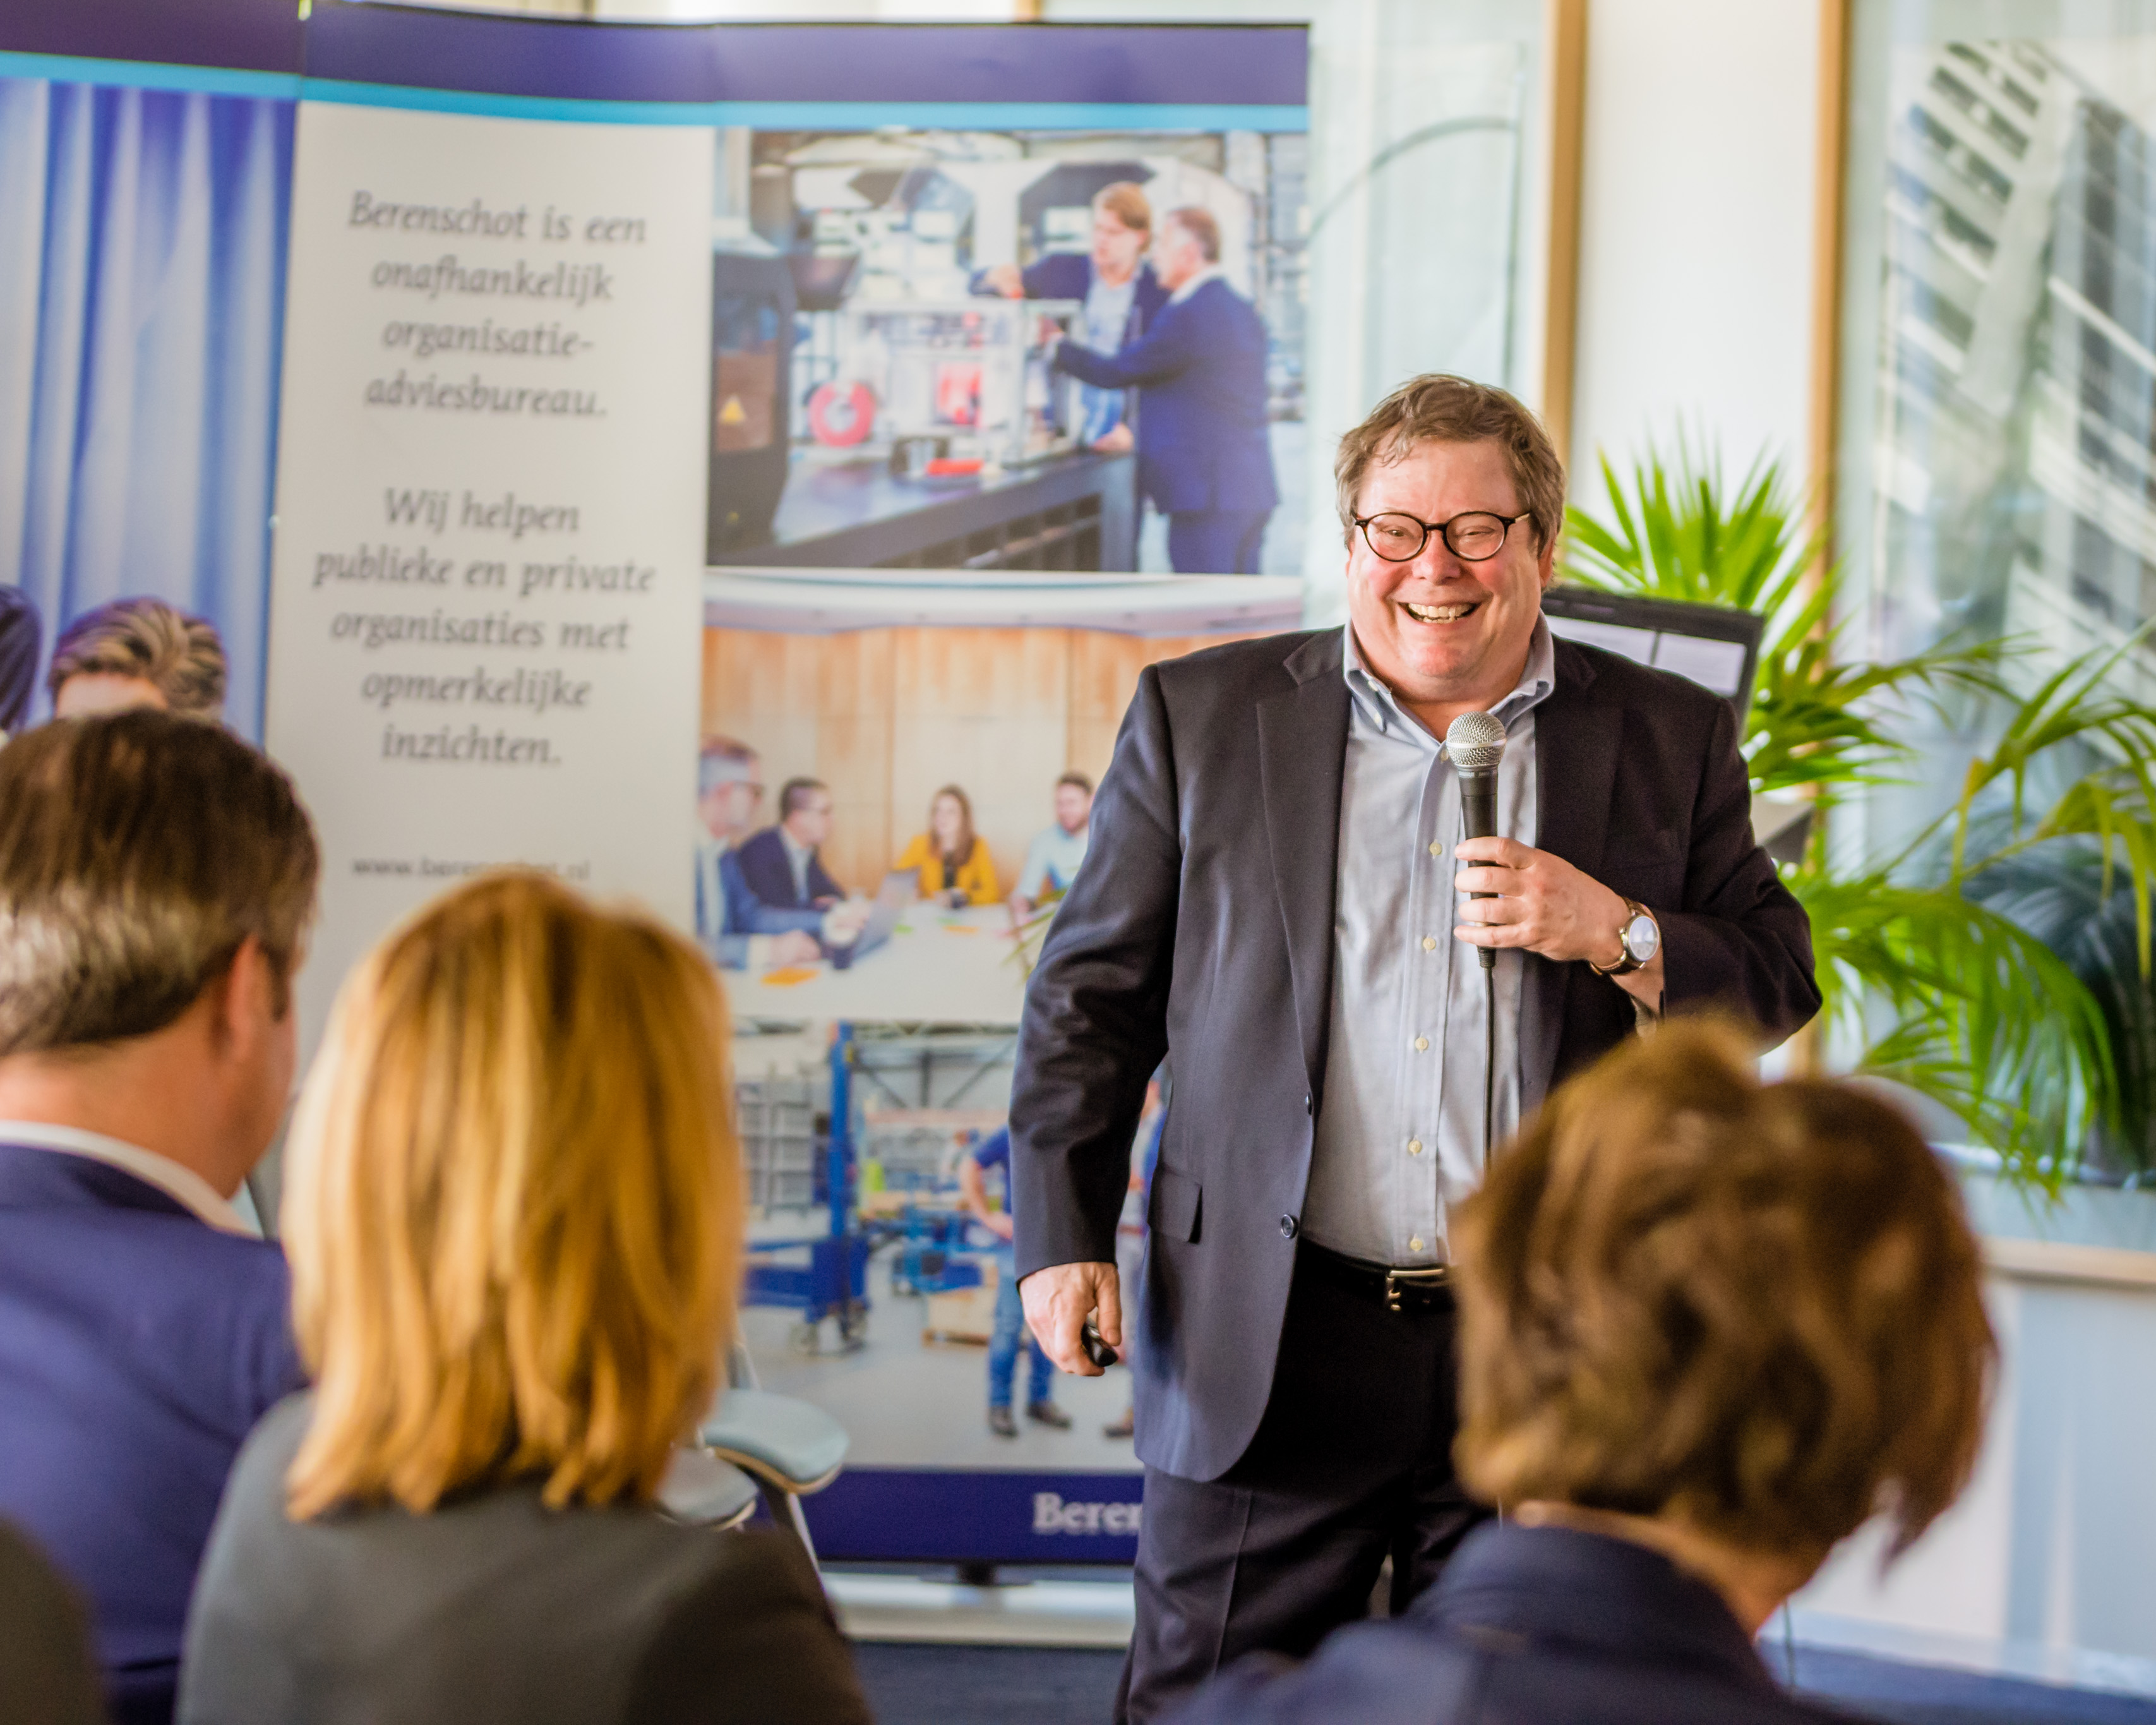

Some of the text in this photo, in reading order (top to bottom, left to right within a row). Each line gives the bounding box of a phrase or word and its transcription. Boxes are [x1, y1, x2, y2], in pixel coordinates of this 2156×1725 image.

[349, 189, 647, 243] Berenschot is een
[371, 254, 614, 307] onafhankelijk
[383, 318, 595, 358] organisatie-
[364, 368, 607, 416] adviesbureau.
[384, 487, 580, 539] Wij helpen
[312, 544, 656, 599] publieke en private
[330, 609, 630, 651] organisaties met
[361, 666, 592, 713] opmerkelijke
[381, 724, 561, 765] inzichten.
